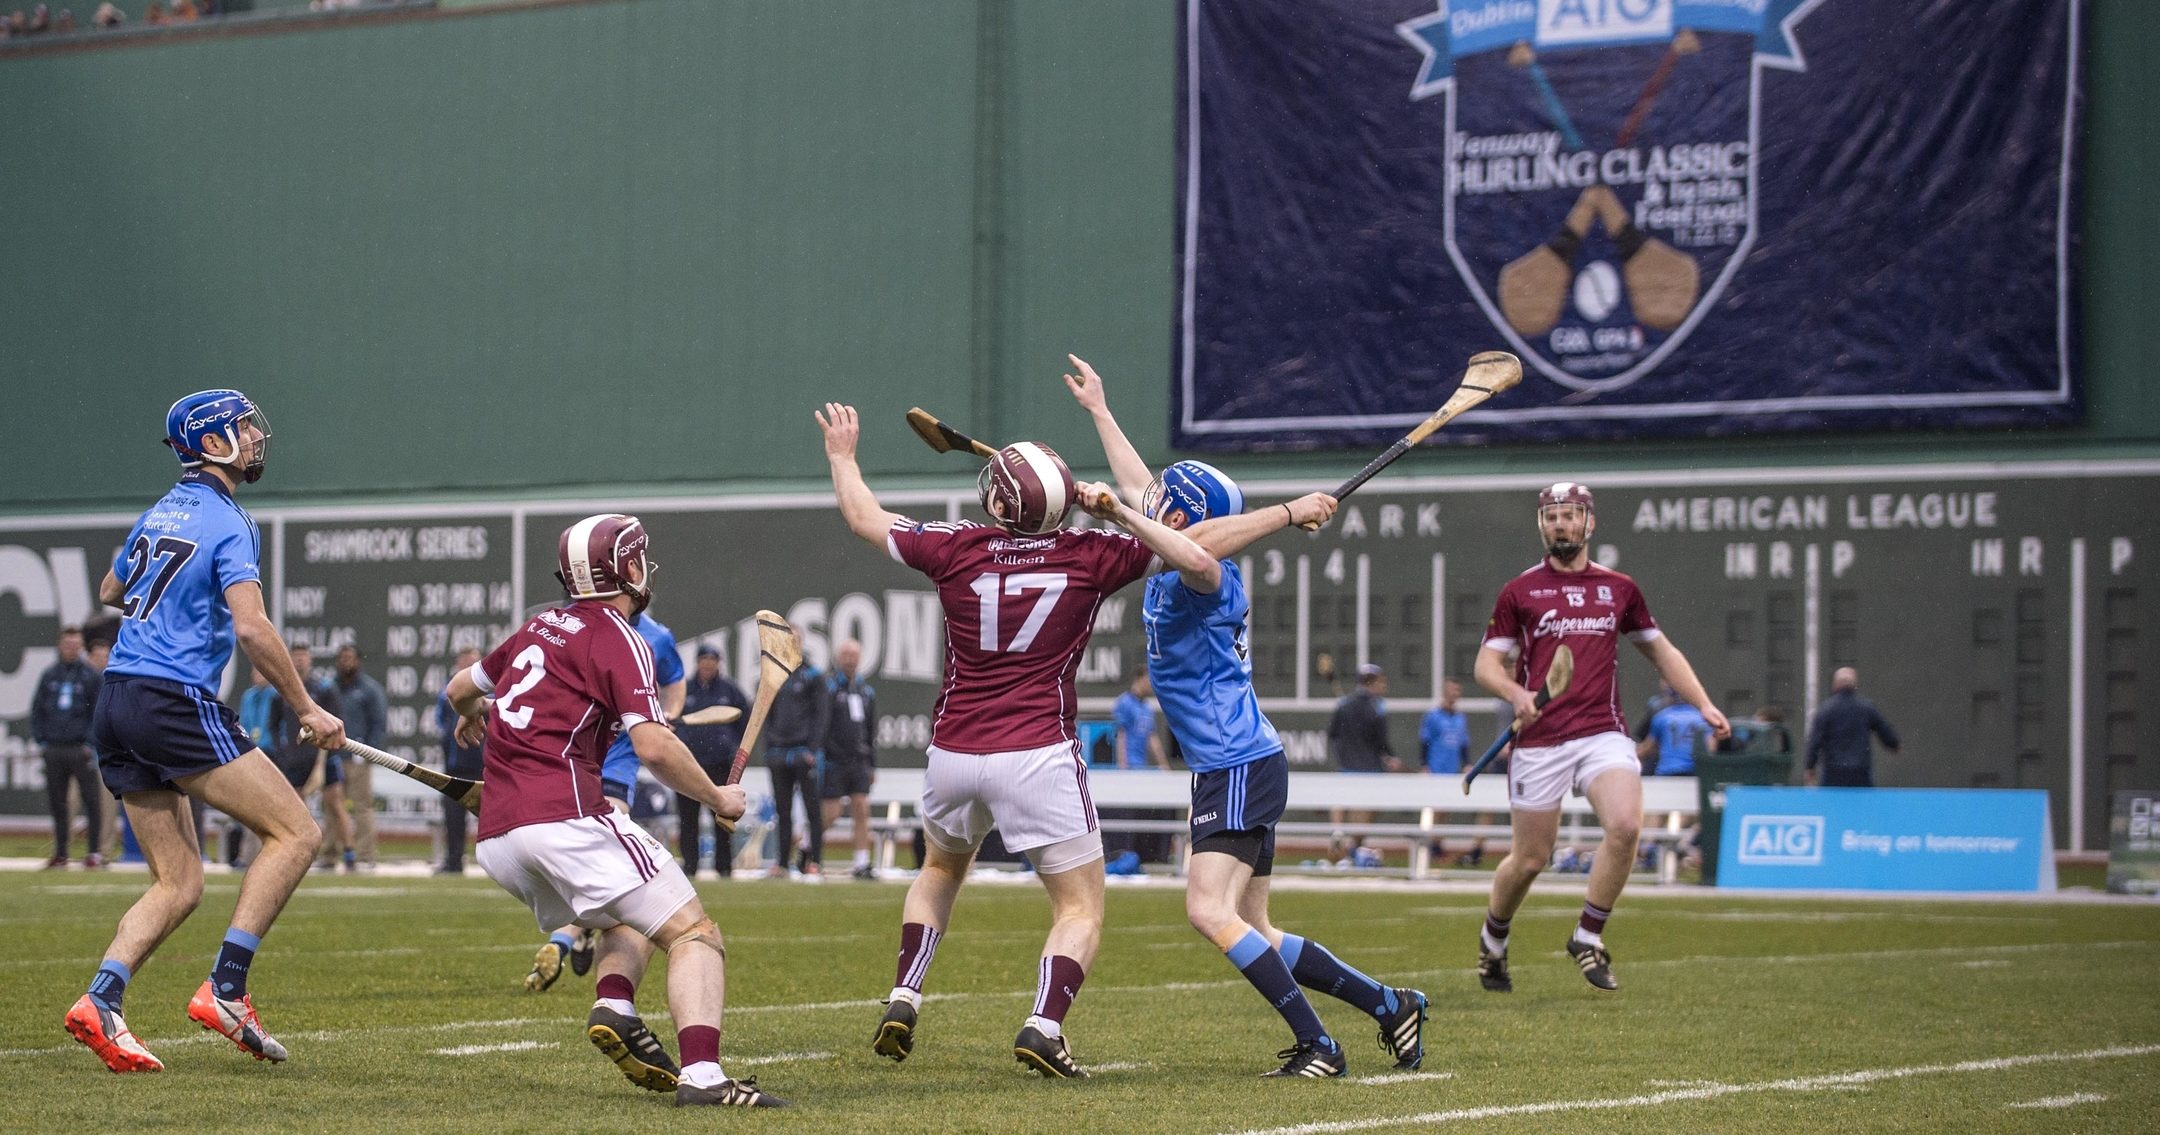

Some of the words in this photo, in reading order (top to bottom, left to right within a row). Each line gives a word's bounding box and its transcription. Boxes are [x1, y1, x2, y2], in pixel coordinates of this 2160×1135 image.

[1452, 0, 1535, 38] Dublin
[1454, 150, 1597, 195] HURLING
[1601, 142, 1749, 185] CLASSIC
[1311, 503, 1444, 538] ARK
[1633, 495, 1829, 532] AMERICAN
[1847, 491, 1998, 529] LEAGUE
[304, 528, 413, 563] SHAMROCK
[417, 526, 488, 560] SERIES
[994, 553, 1045, 565] Killeen
[1725, 542, 1757, 579] IN
[1769, 542, 1793, 579] R
[1832, 540, 1855, 578] P
[1971, 541, 2002, 577] IN
[2019, 537, 2043, 576] R
[2111, 537, 2134, 575] P
[123, 534, 198, 622] 27
[1263, 548, 1285, 586] 3
[1324, 547, 1346, 585] 4
[284, 585, 327, 618] INDY
[387, 585, 419, 617] ND
[420, 583, 448, 616] 30
[449, 583, 486, 616] PUR
[489, 581, 513, 615] 14
[970, 572, 1068, 652] 17
[1566, 593, 1585, 607] 13
[284, 625, 357, 659] DALLAS
[387, 625, 419, 658] ND
[420, 624, 450, 657] 37
[451, 624, 486, 656] ASU
[537, 626, 566, 648] Burke
[1533, 608, 1616, 639] Supermac's
[387, 665, 418, 698] ND
[496, 644, 547, 730] 2
[387, 705, 418, 737] ND
[1750, 825, 1813, 856] AIG
[1841, 829, 1892, 857] Bring
[1895, 835, 1920, 851] on
[1925, 832, 2018, 852] tomorrow
